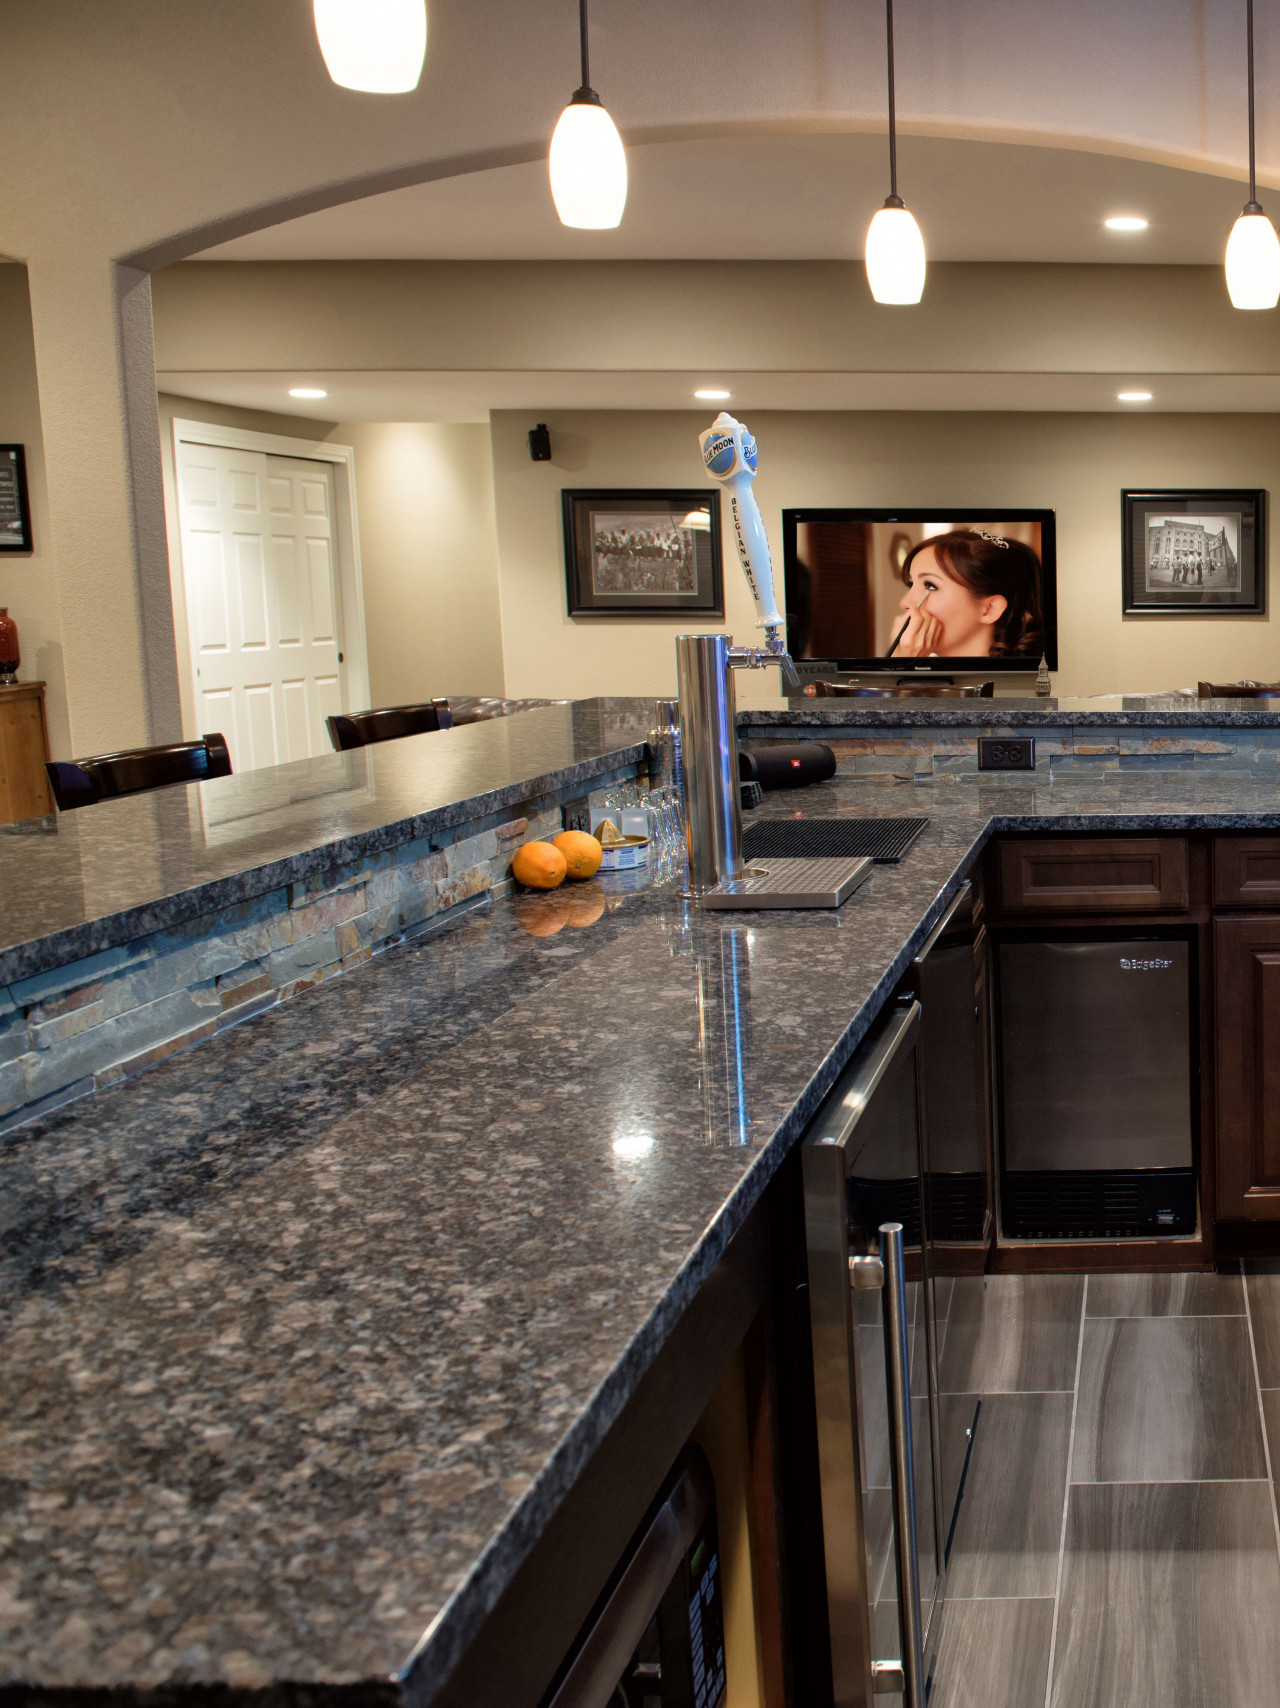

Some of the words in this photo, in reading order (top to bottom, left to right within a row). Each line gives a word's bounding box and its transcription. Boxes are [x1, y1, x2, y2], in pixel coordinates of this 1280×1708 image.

[712, 436, 735, 455] MOON
[731, 497, 746, 555] BELGIAN
[742, 560, 760, 601] WHITE
